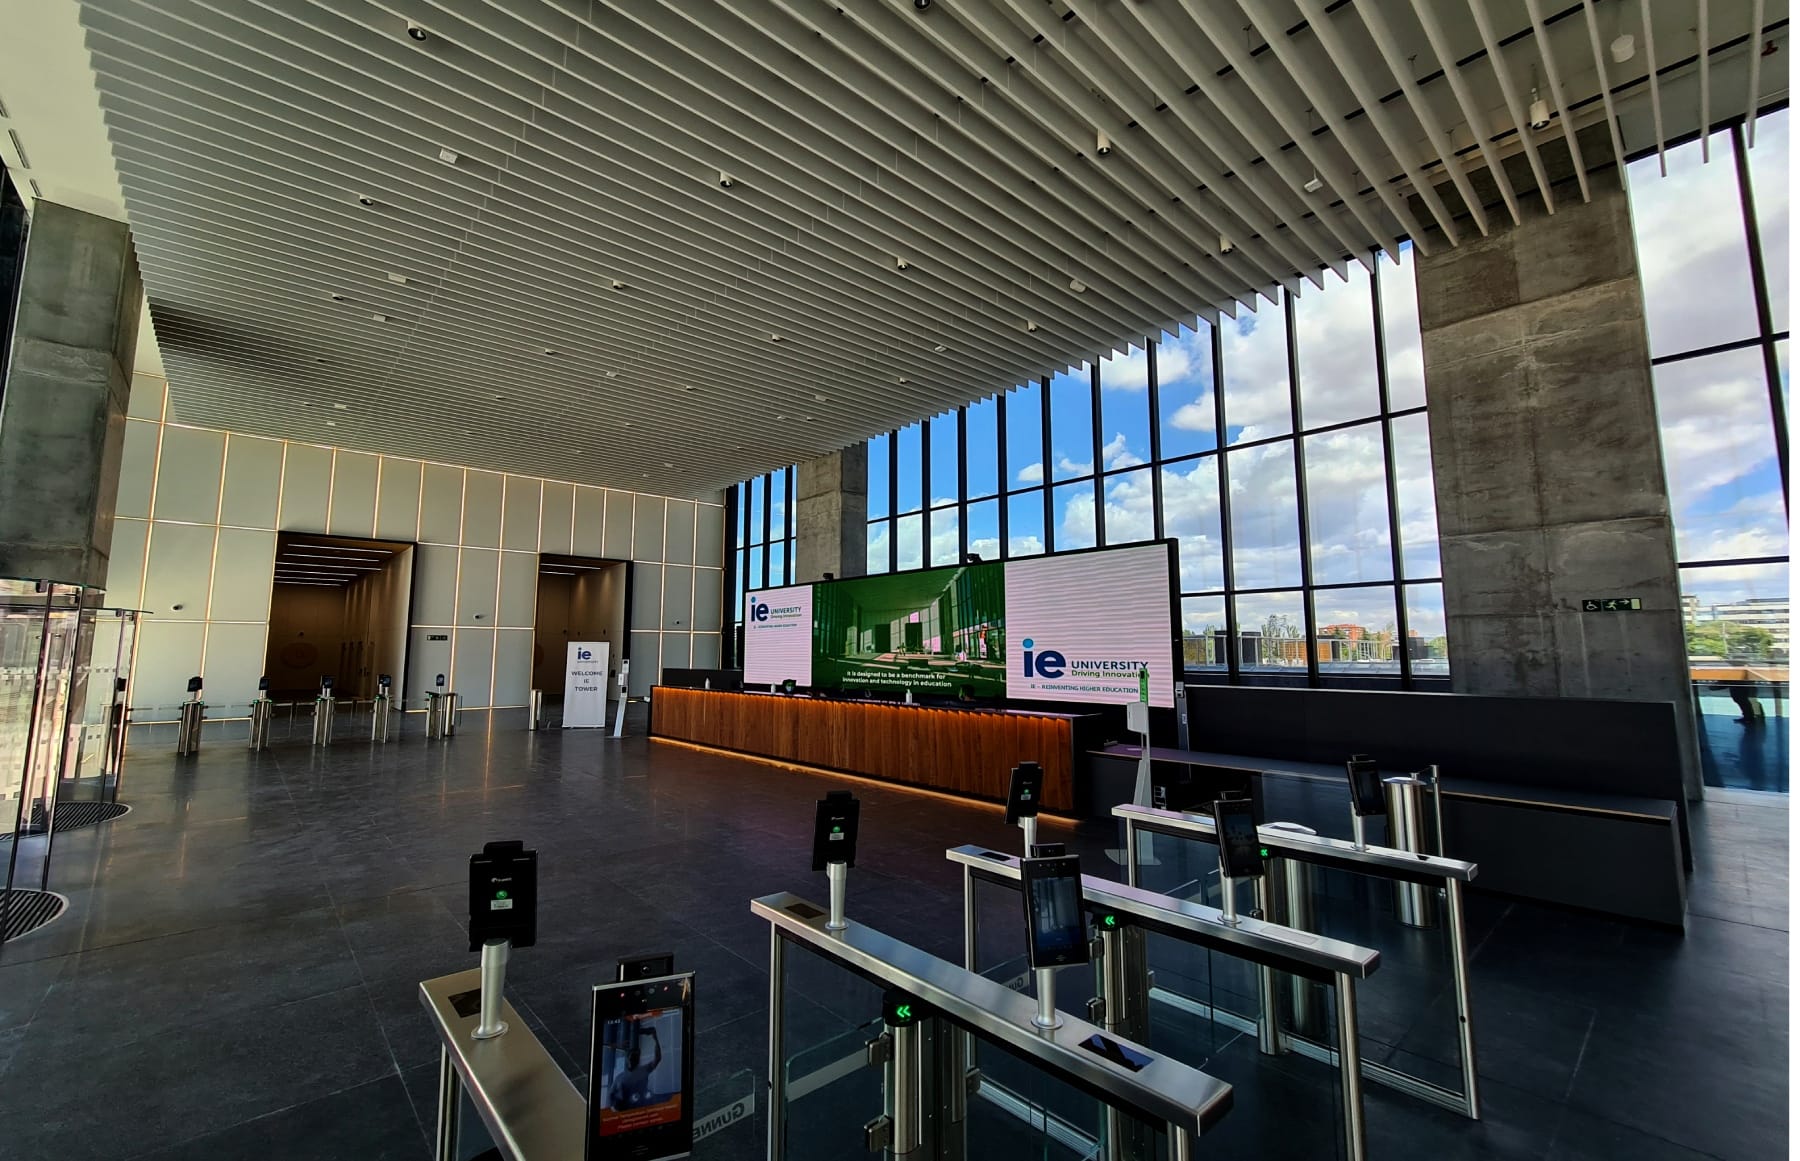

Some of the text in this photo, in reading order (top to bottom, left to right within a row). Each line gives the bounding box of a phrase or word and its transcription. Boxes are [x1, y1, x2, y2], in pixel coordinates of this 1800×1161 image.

[751, 597, 769, 622] ie
[578, 647, 592, 660] ie
[1022, 638, 1067, 679] ie
[1071, 661, 1149, 670] UNIVERSITY
[1071, 670, 1150, 678] Driving Innovati
[880, 678, 912, 686] technology
[920, 680, 952, 688] education
[1102, 686, 1139, 694] EDUCATION
